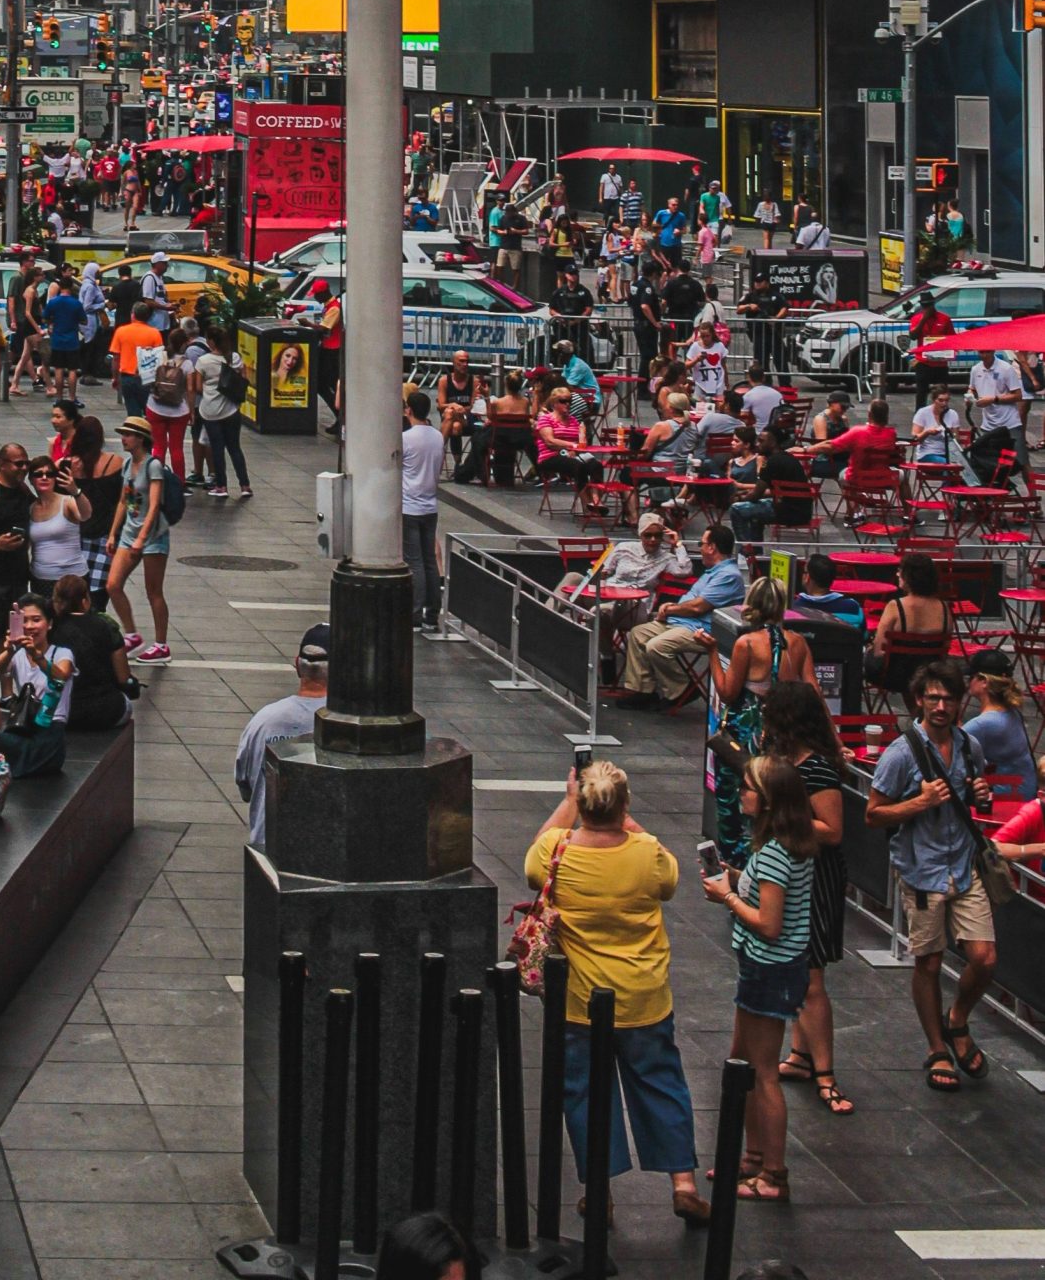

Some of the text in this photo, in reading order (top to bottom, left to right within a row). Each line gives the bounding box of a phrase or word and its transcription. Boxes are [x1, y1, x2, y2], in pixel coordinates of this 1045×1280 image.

[41, 91, 75, 102] CELTIC
[868, 90, 893, 101] W 46
[15, 111, 31, 120] WAY
[256, 115, 324, 129] COFFEED
[448, 323, 506, 345] NYPD
[699, 367, 722, 382] NY
